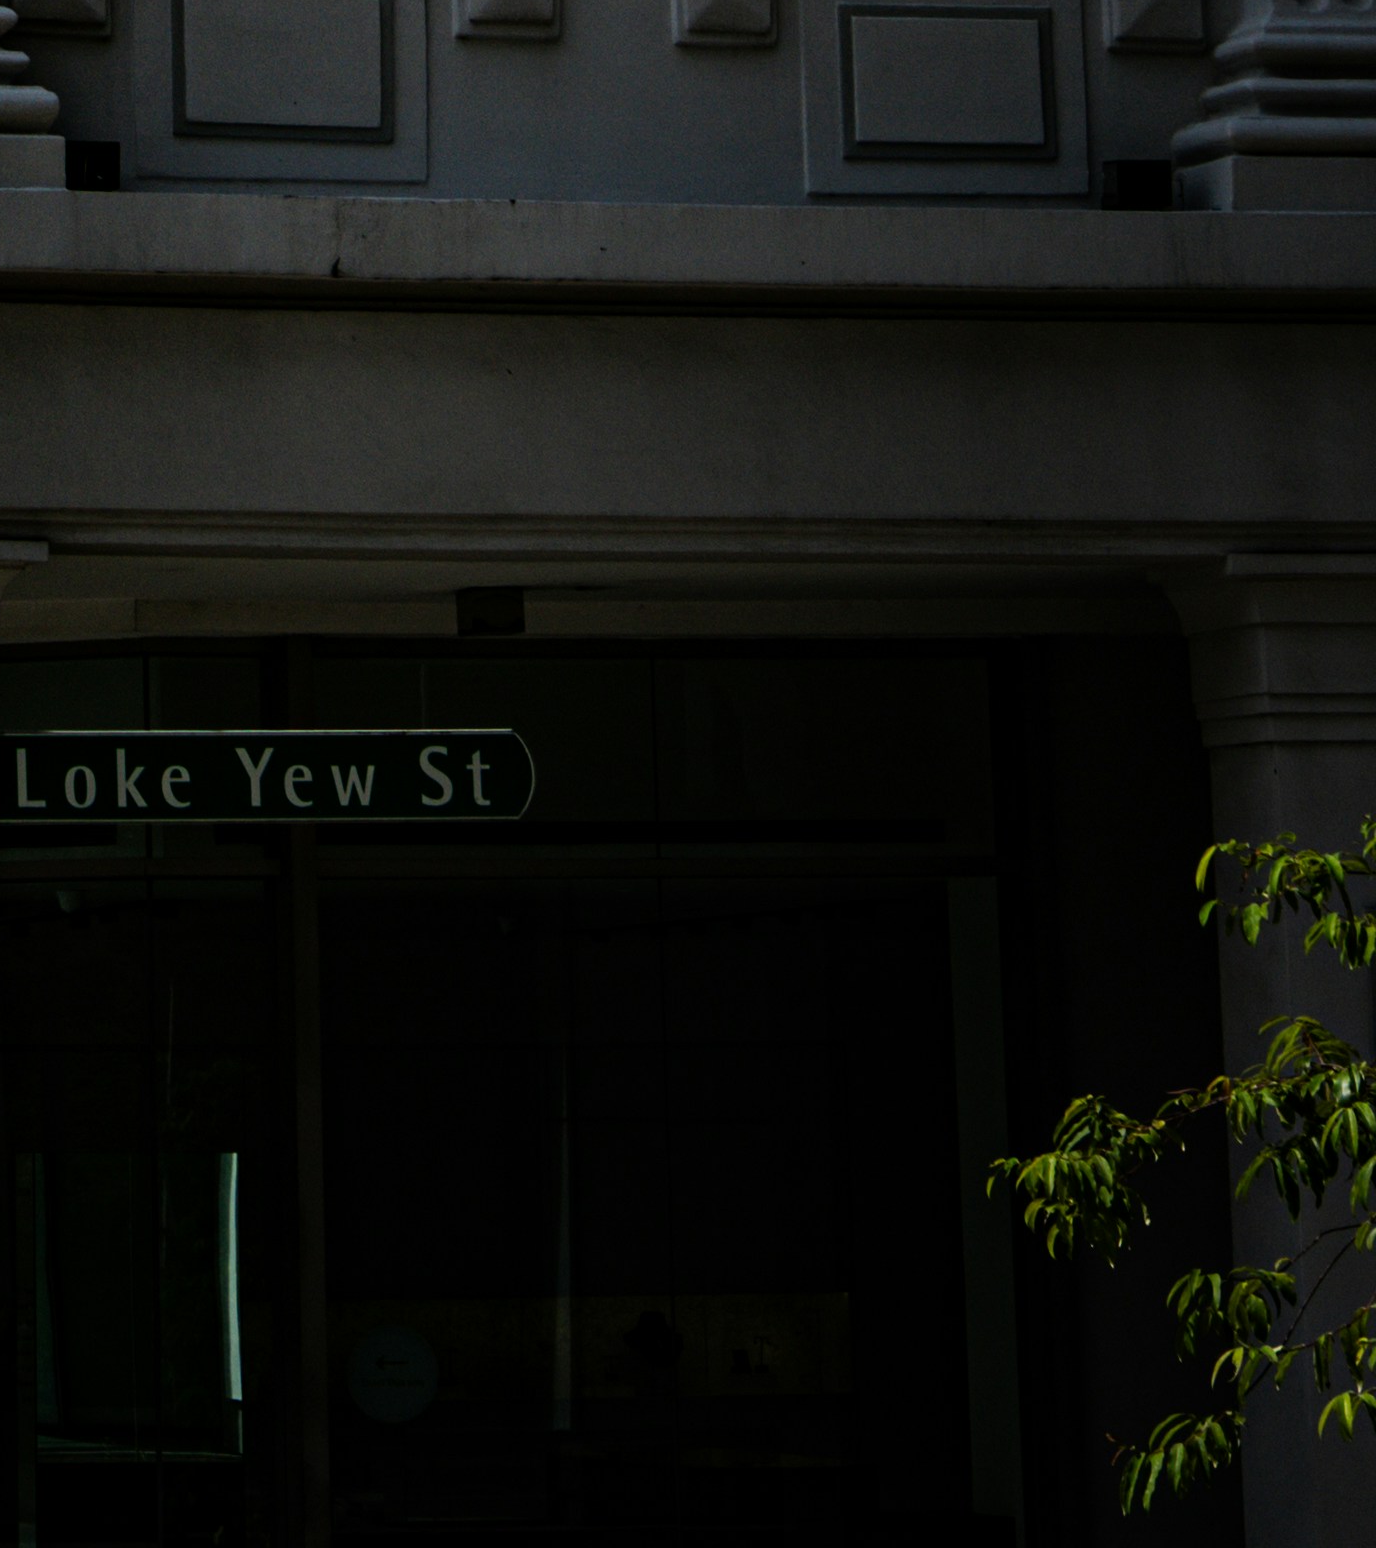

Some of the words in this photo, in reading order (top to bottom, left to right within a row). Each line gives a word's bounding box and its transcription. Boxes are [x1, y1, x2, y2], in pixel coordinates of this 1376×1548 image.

[15, 746, 193, 809] Loke
[234, 746, 376, 808] Yew
[418, 744, 492, 808] St
